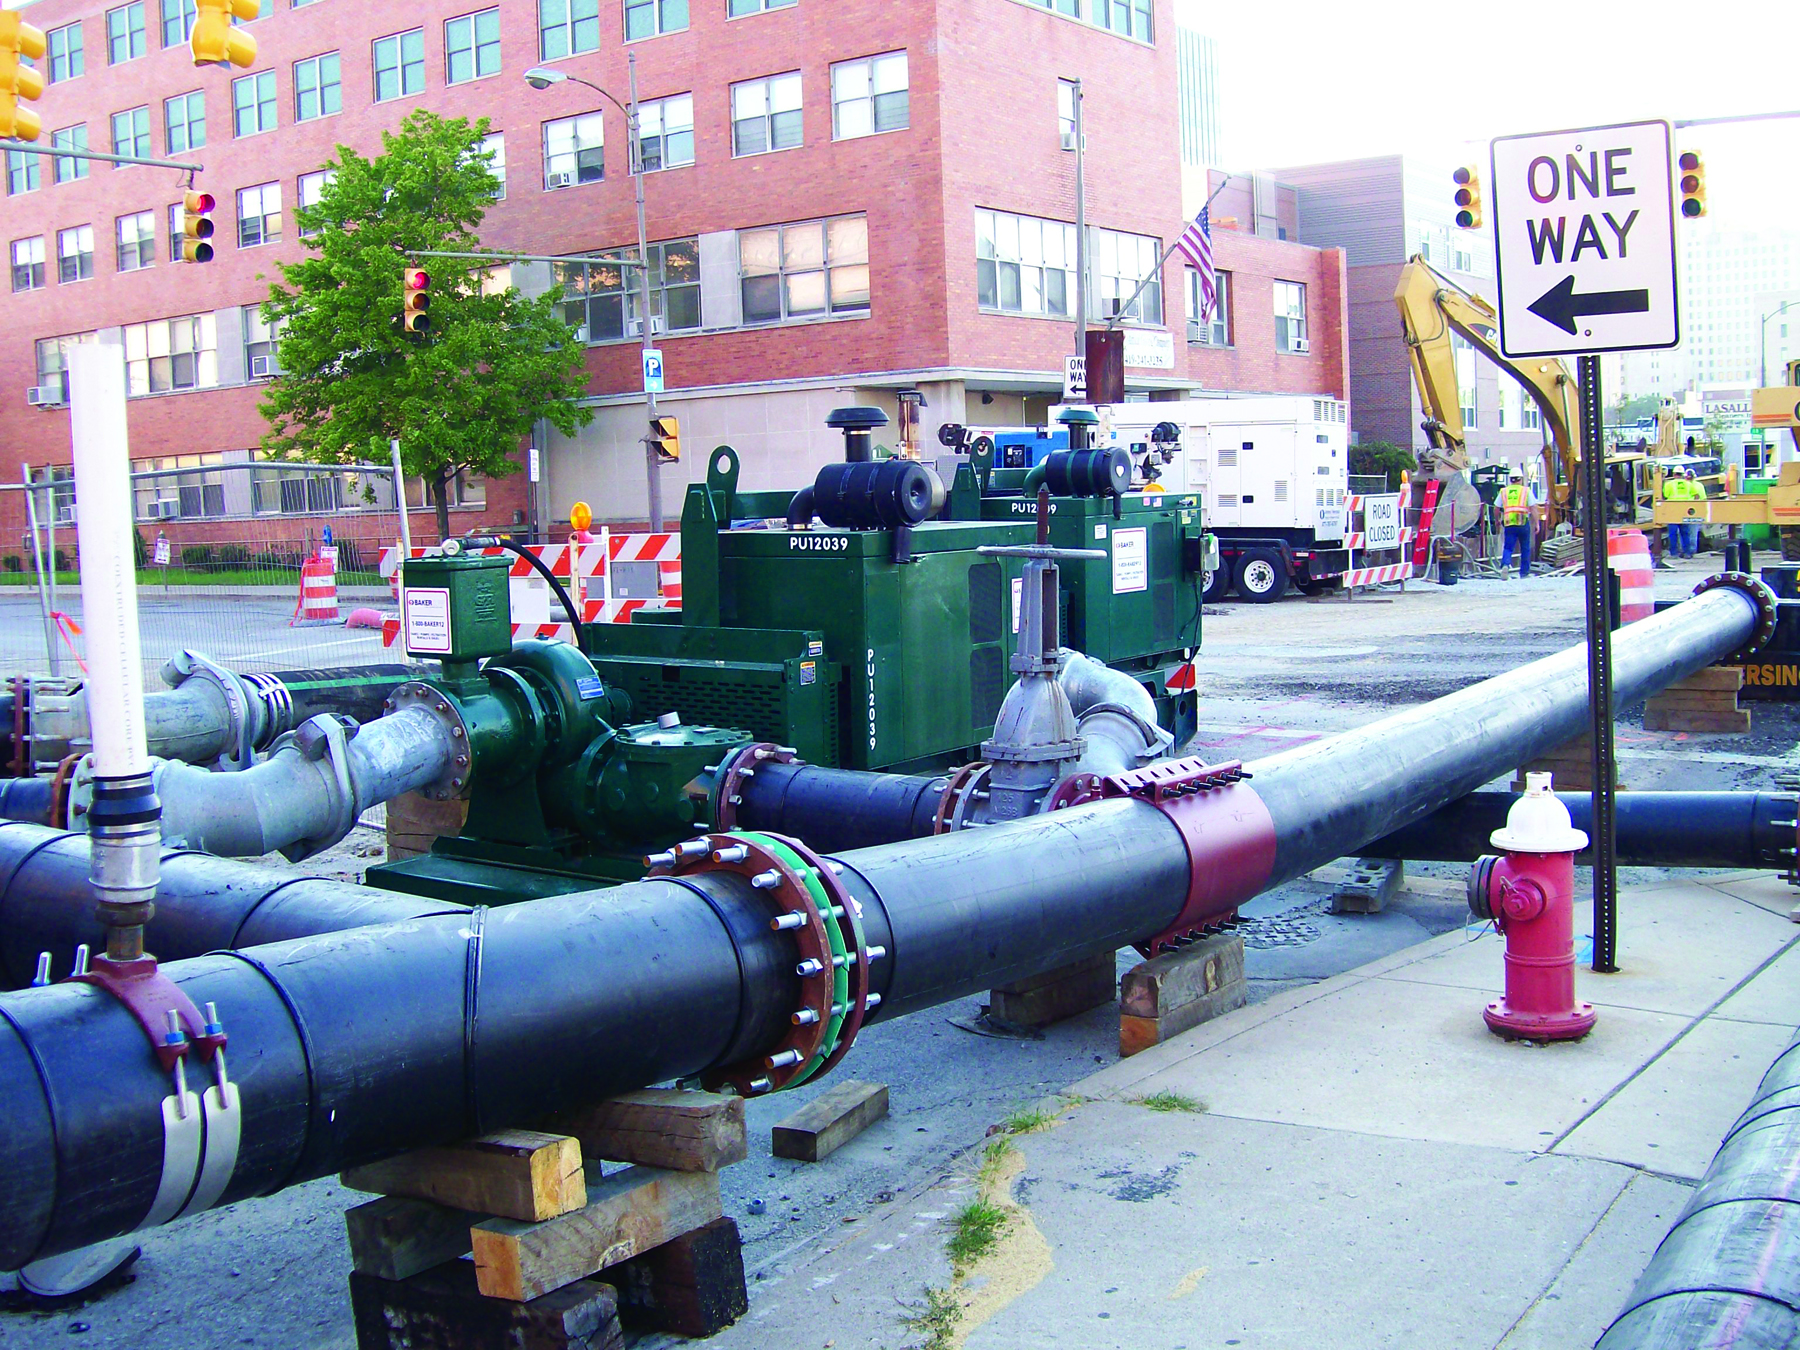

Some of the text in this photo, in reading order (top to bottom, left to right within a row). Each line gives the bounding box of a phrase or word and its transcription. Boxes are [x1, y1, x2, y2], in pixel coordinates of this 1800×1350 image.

[1527, 147, 1636, 204] ONE
[1526, 209, 1641, 266] WAY
[648, 358, 659, 376] P
[1011, 502, 1057, 515] PU129
[1372, 503, 1391, 519] ROAD
[1369, 525, 1395, 542] CLOSED
[790, 536, 848, 551] PU12039
[867, 648, 876, 751] PU12039
